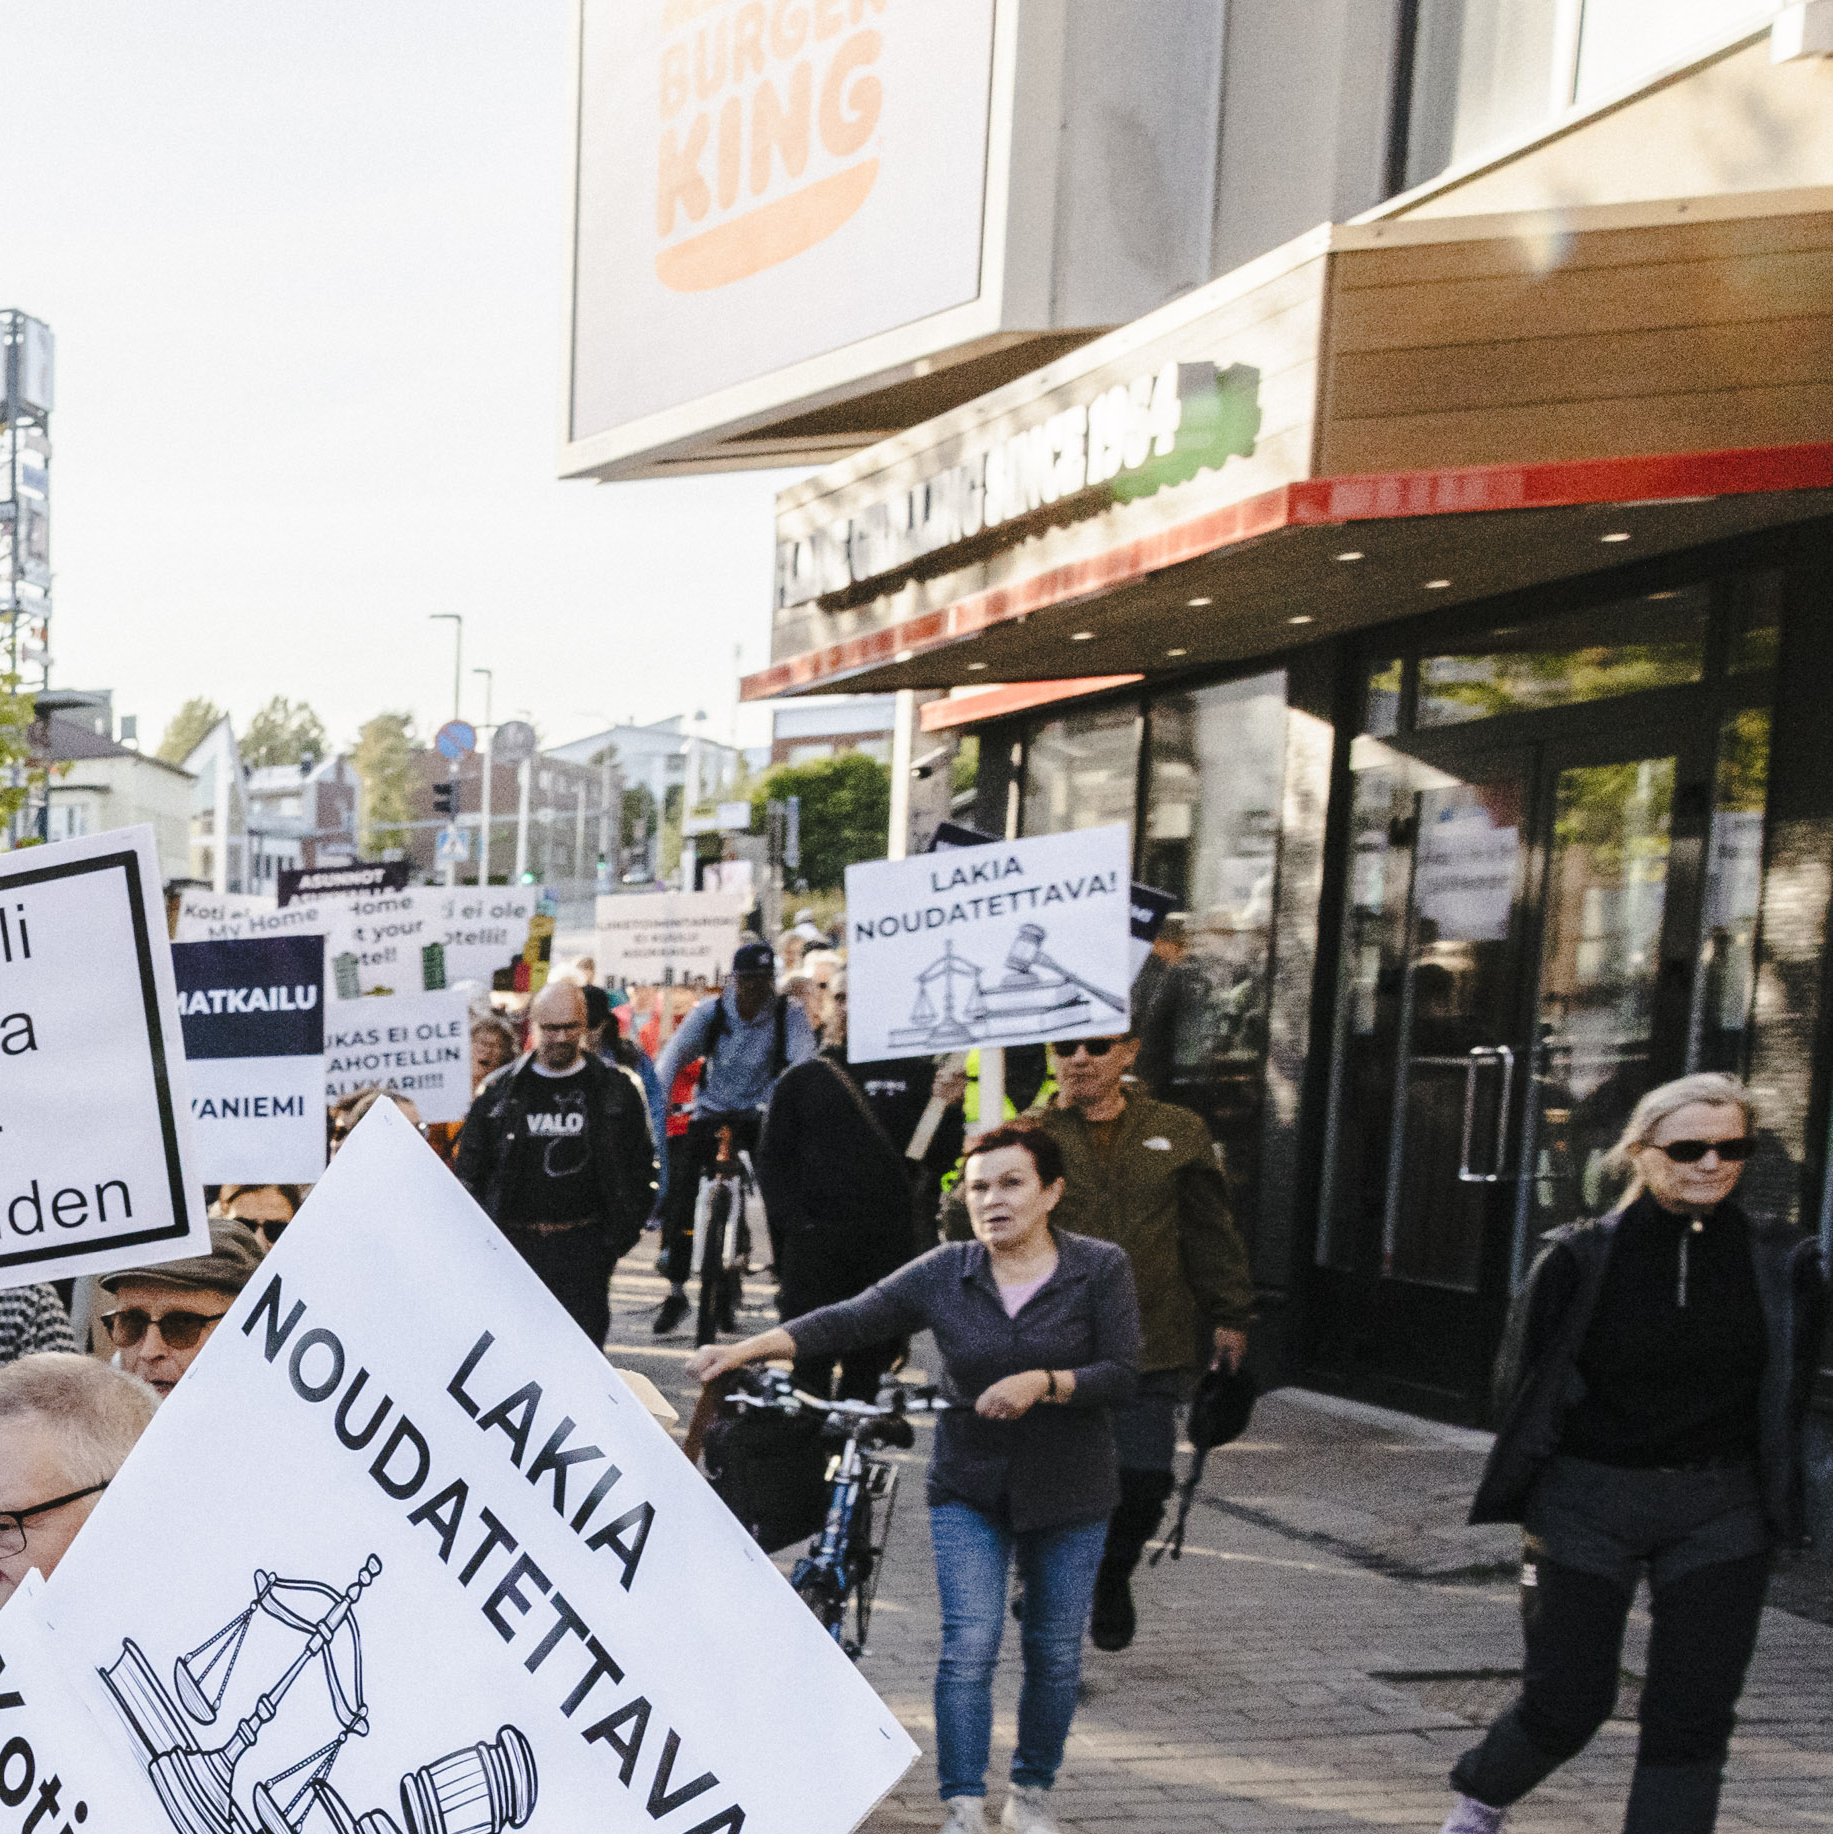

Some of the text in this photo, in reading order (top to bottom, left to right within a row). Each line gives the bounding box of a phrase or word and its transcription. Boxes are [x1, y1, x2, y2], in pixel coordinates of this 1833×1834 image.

[655, 29, 883, 239] KING
[930, 855, 1024, 893] LAKIA
[248, 907, 320, 934] Home
[489, 901, 528, 919] ole
[854, 871, 1118, 944] NOUDATETTAVA!
[372, 919, 424, 944] your
[387, 1026, 408, 1044] EI
[415, 1020, 462, 1041] OLE
[191, 1094, 305, 1119] ANIEMI
[526, 1112, 584, 1134] VALO
[445, 1331, 657, 1592] LAKIA
